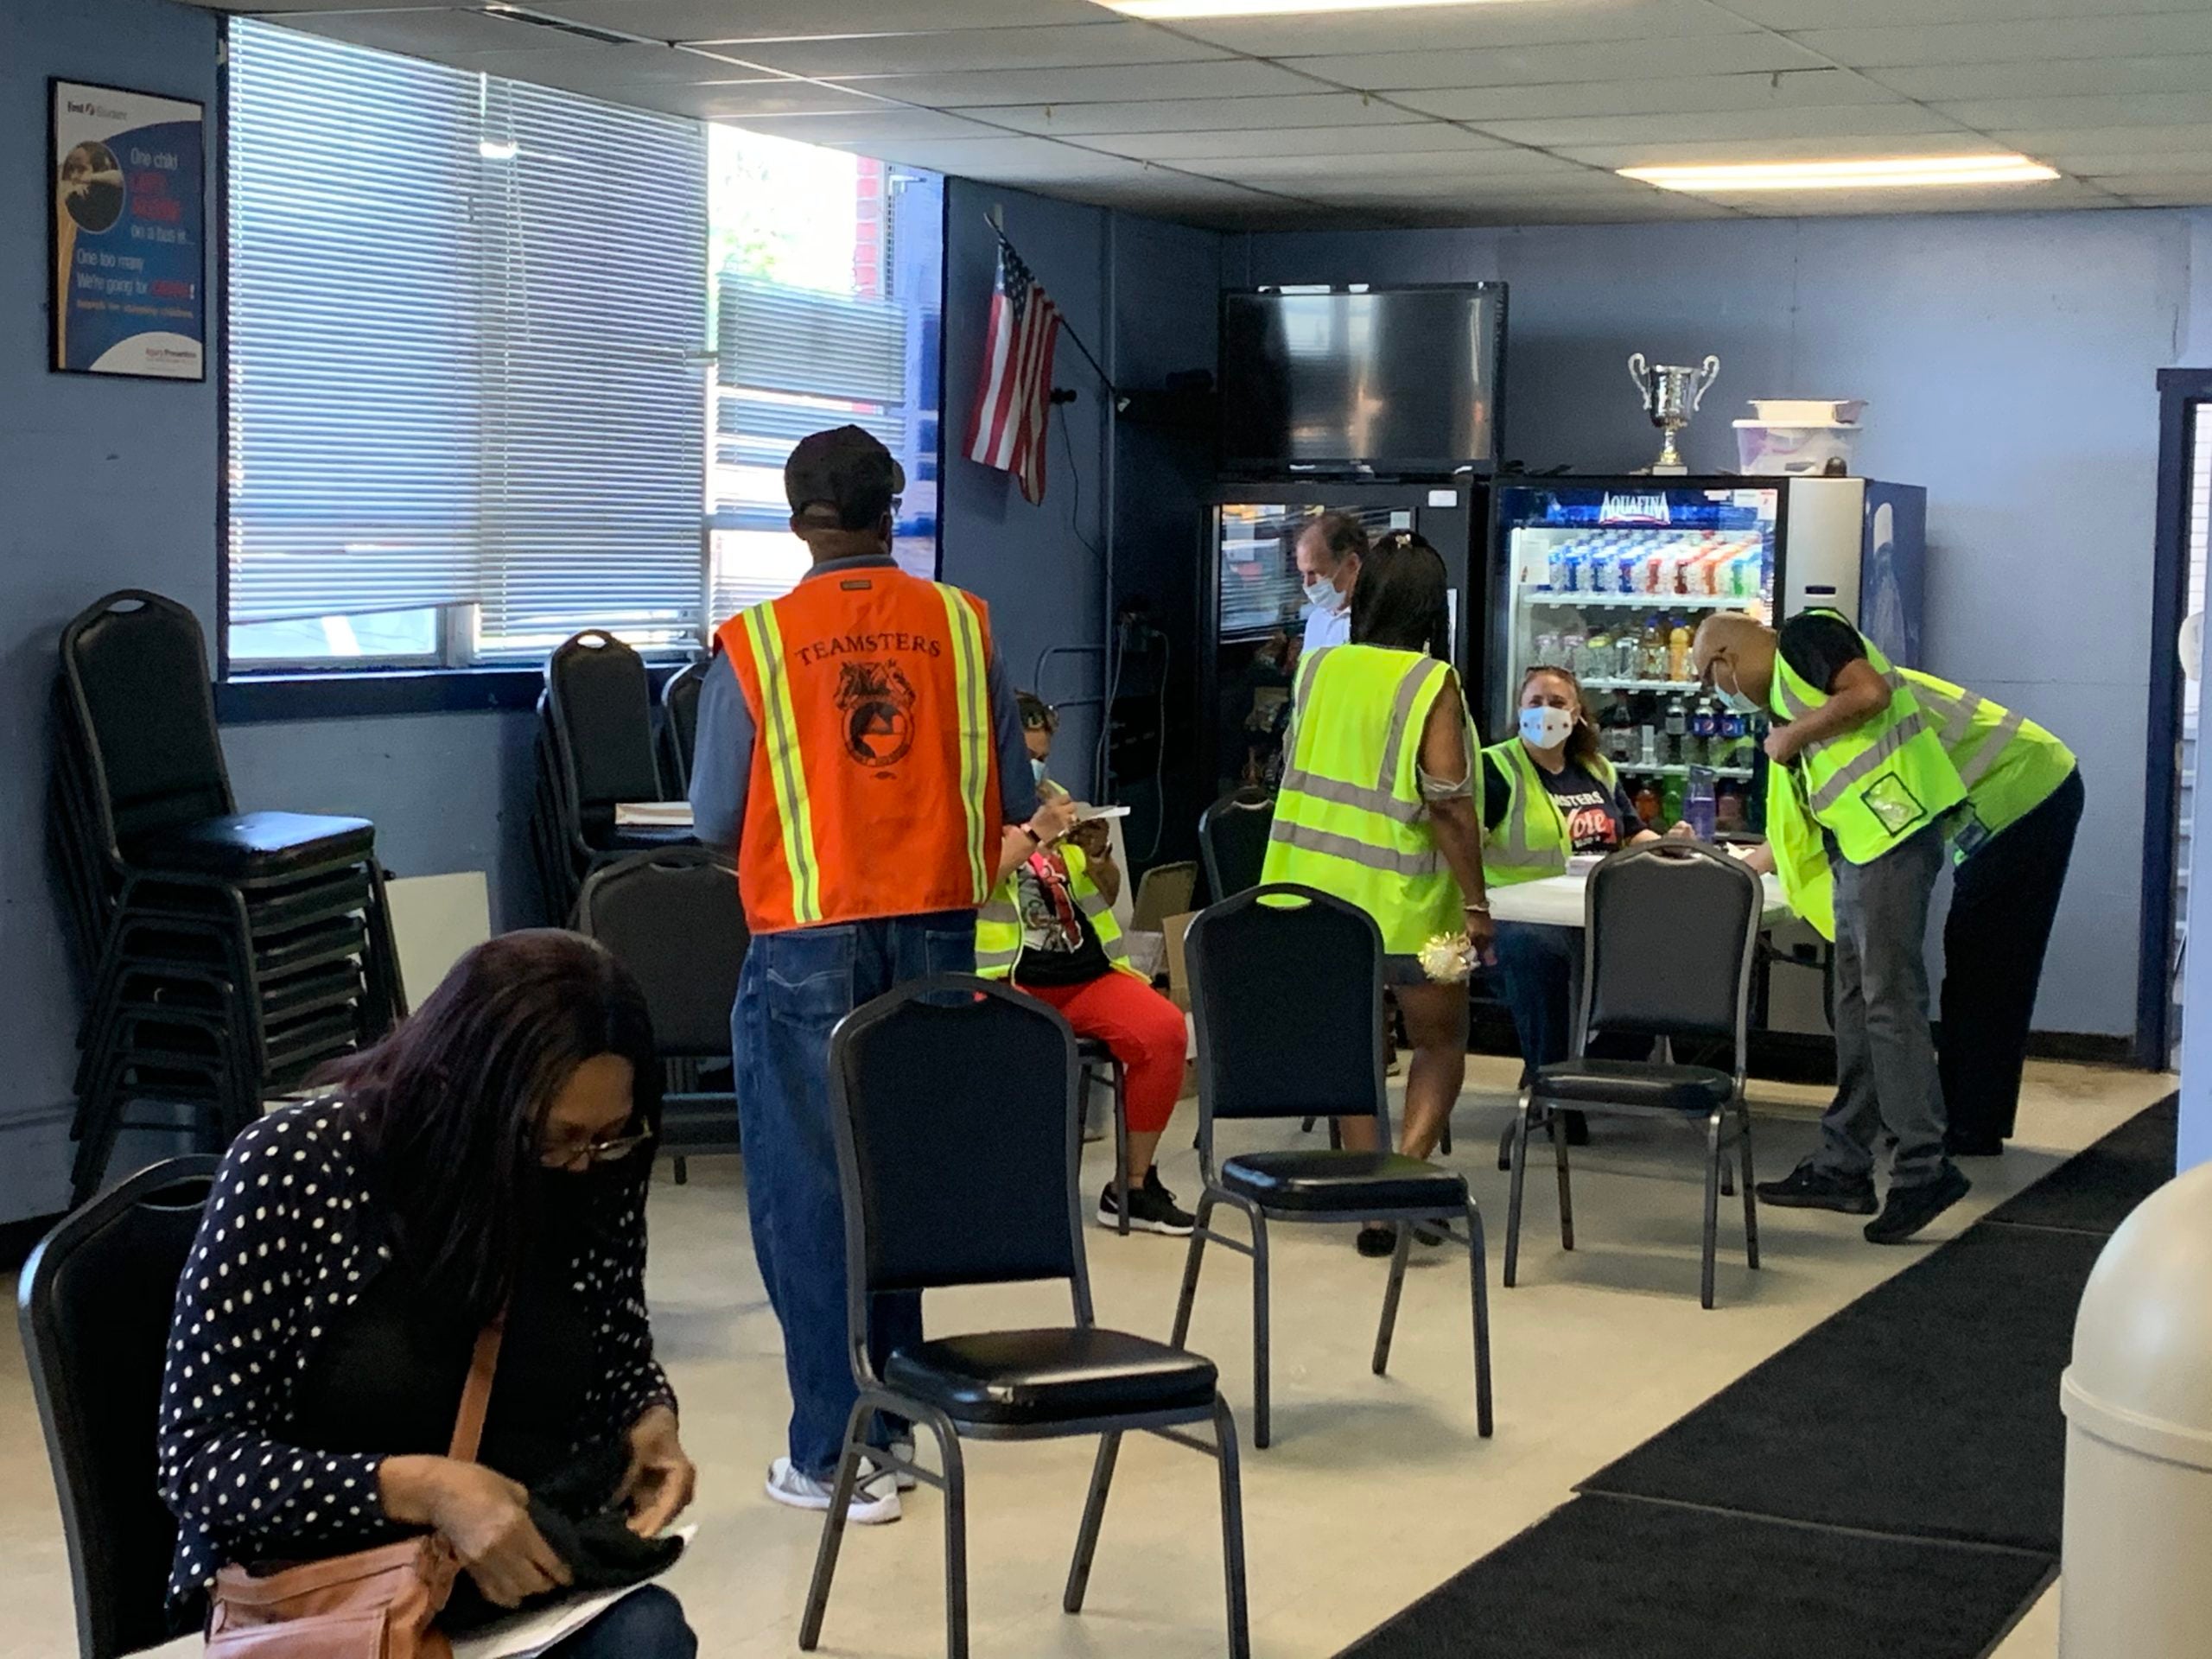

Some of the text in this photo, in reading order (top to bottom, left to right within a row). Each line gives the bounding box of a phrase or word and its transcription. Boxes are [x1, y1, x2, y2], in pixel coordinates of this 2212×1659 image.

[77, 248, 98, 265] One
[1599, 491, 1670, 524] AQUAFINA
[794, 632, 941, 666] TEAMSTERS
